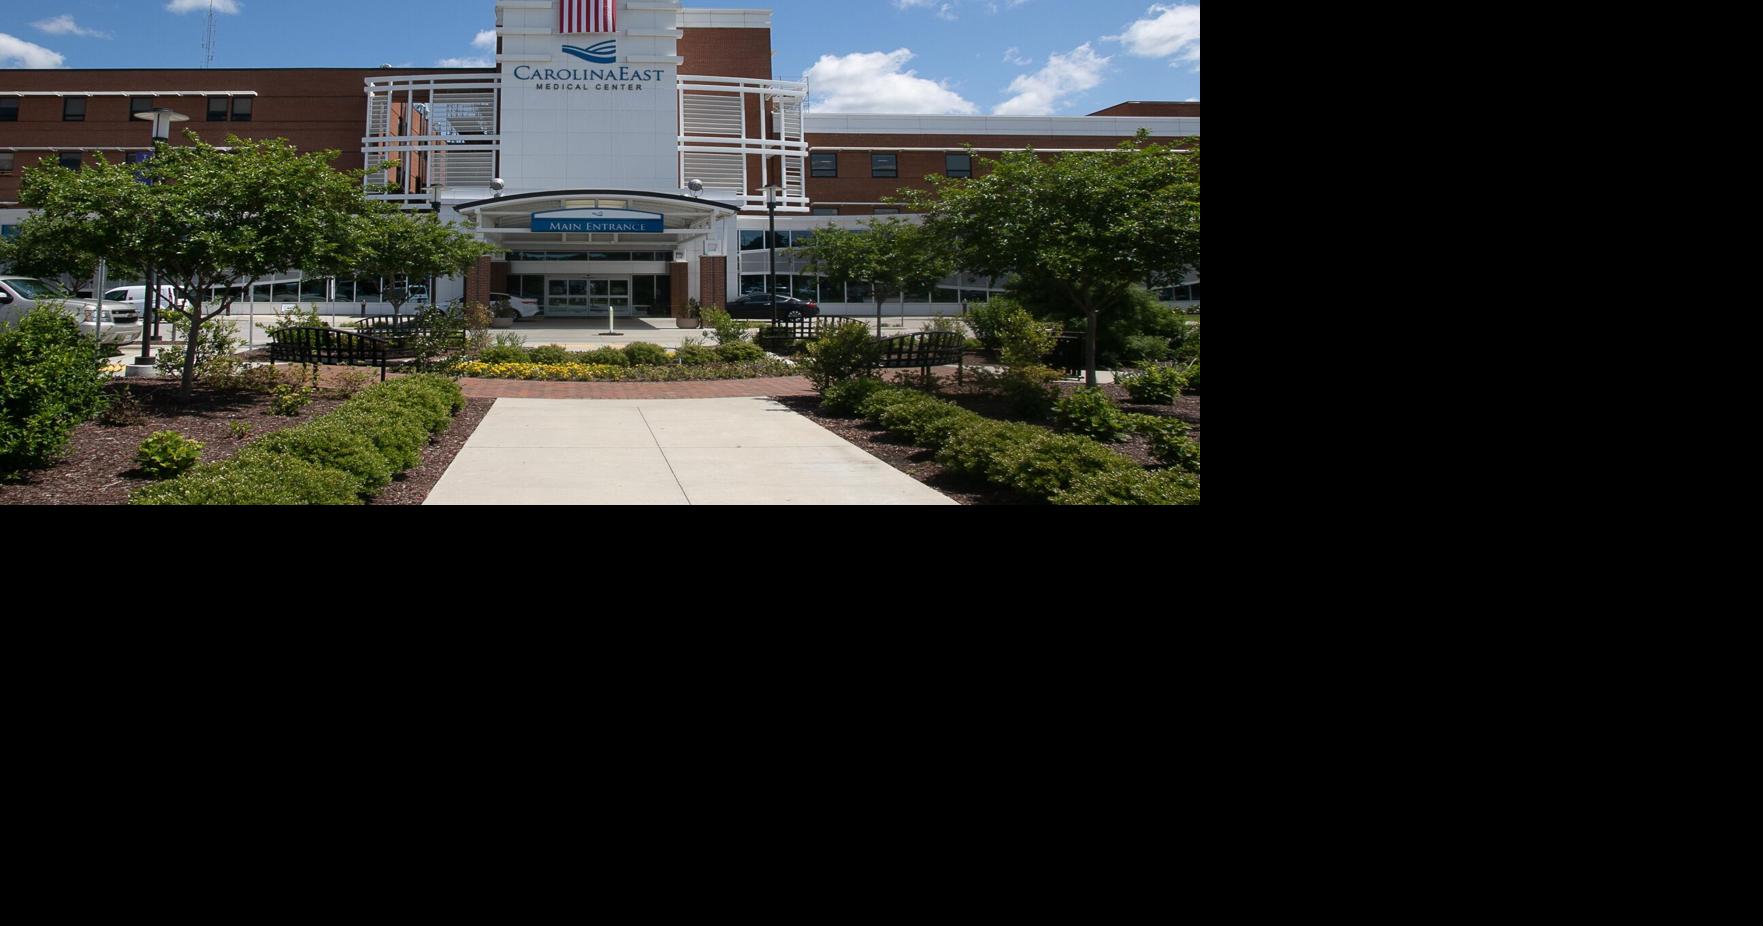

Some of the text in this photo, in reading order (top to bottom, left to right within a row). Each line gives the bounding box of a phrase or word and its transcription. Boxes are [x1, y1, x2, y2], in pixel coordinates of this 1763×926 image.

[536, 83, 643, 91] MEDICAL CENTER
[550, 221, 646, 231] MAIN ENTRANCE
